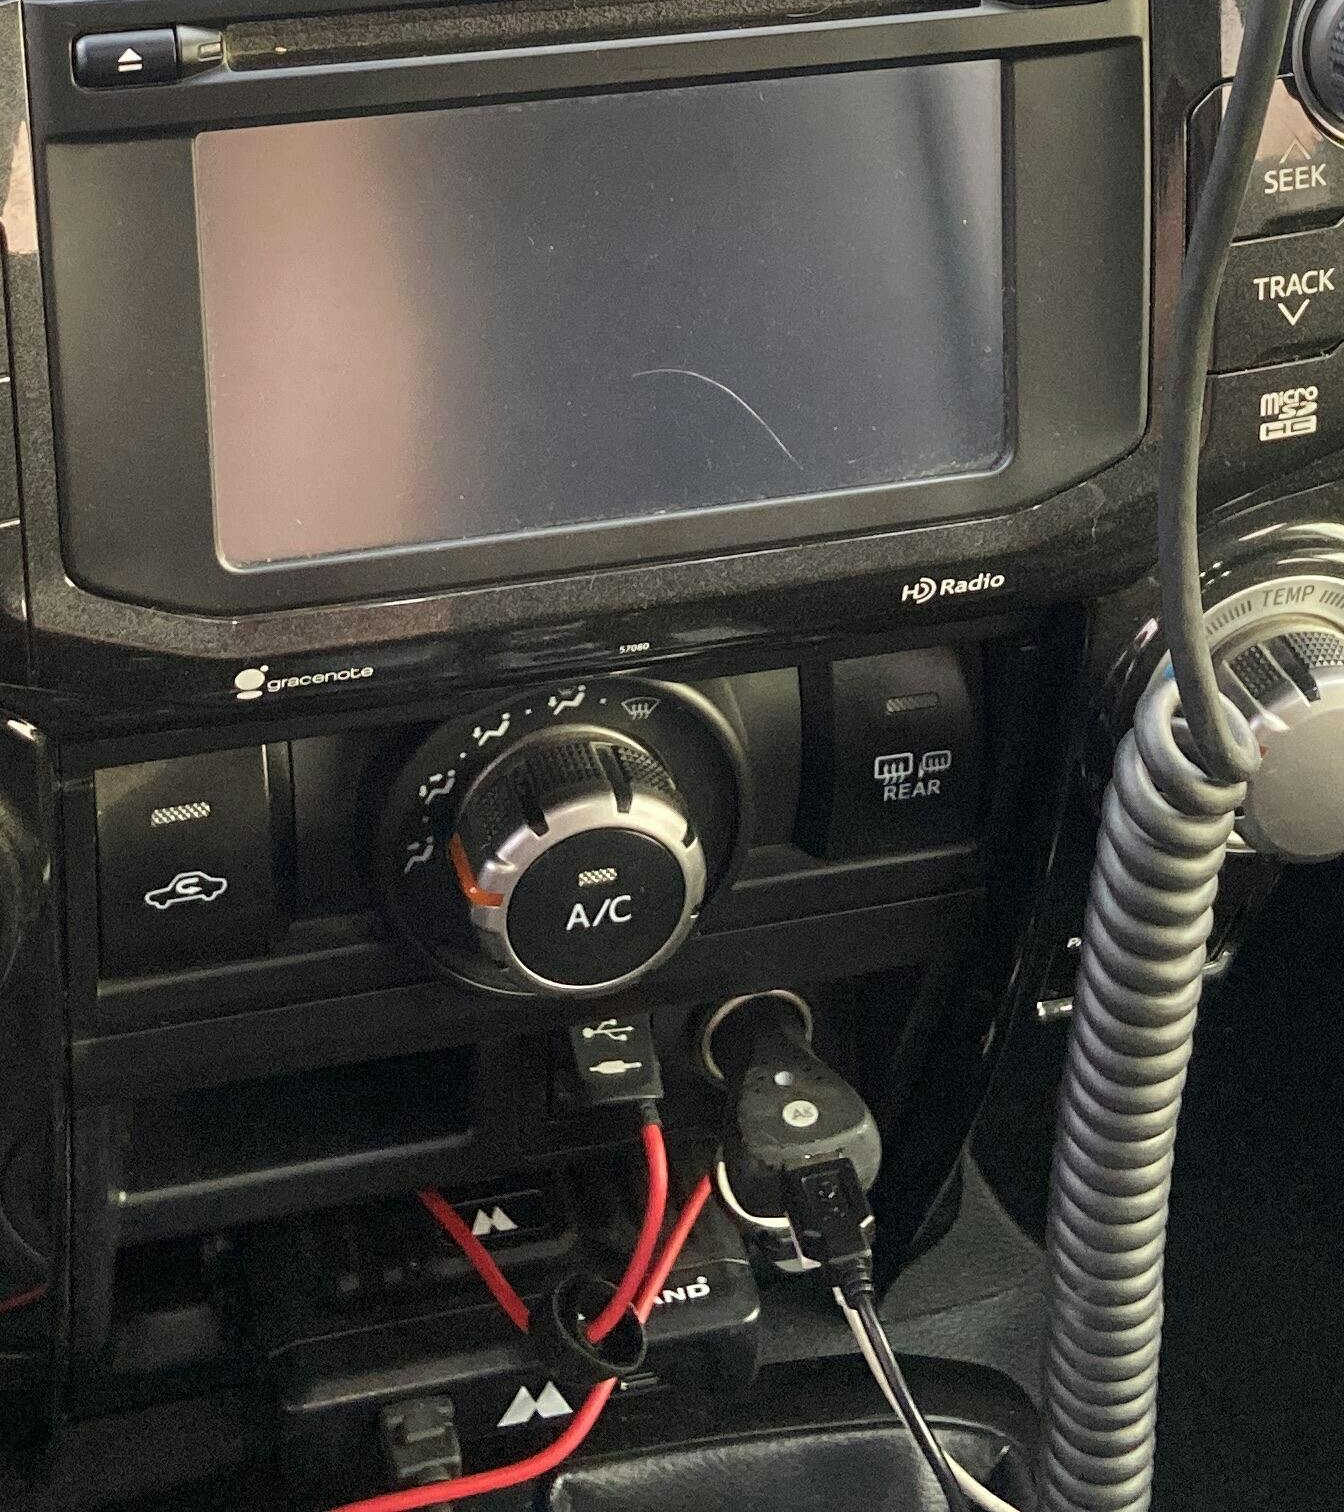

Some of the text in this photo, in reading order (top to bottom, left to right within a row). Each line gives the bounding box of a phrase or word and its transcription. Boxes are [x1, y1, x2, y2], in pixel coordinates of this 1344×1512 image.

[1264, 164, 1326, 193] SEEK
[1253, 268, 1336, 301] TRACK
[902, 572, 1006, 604] HD Radio
[1261, 585, 1315, 608] TEMP
[267, 667, 374, 693] gracenote
[883, 778, 942, 802] REAR
[566, 894, 633, 931] A/C
